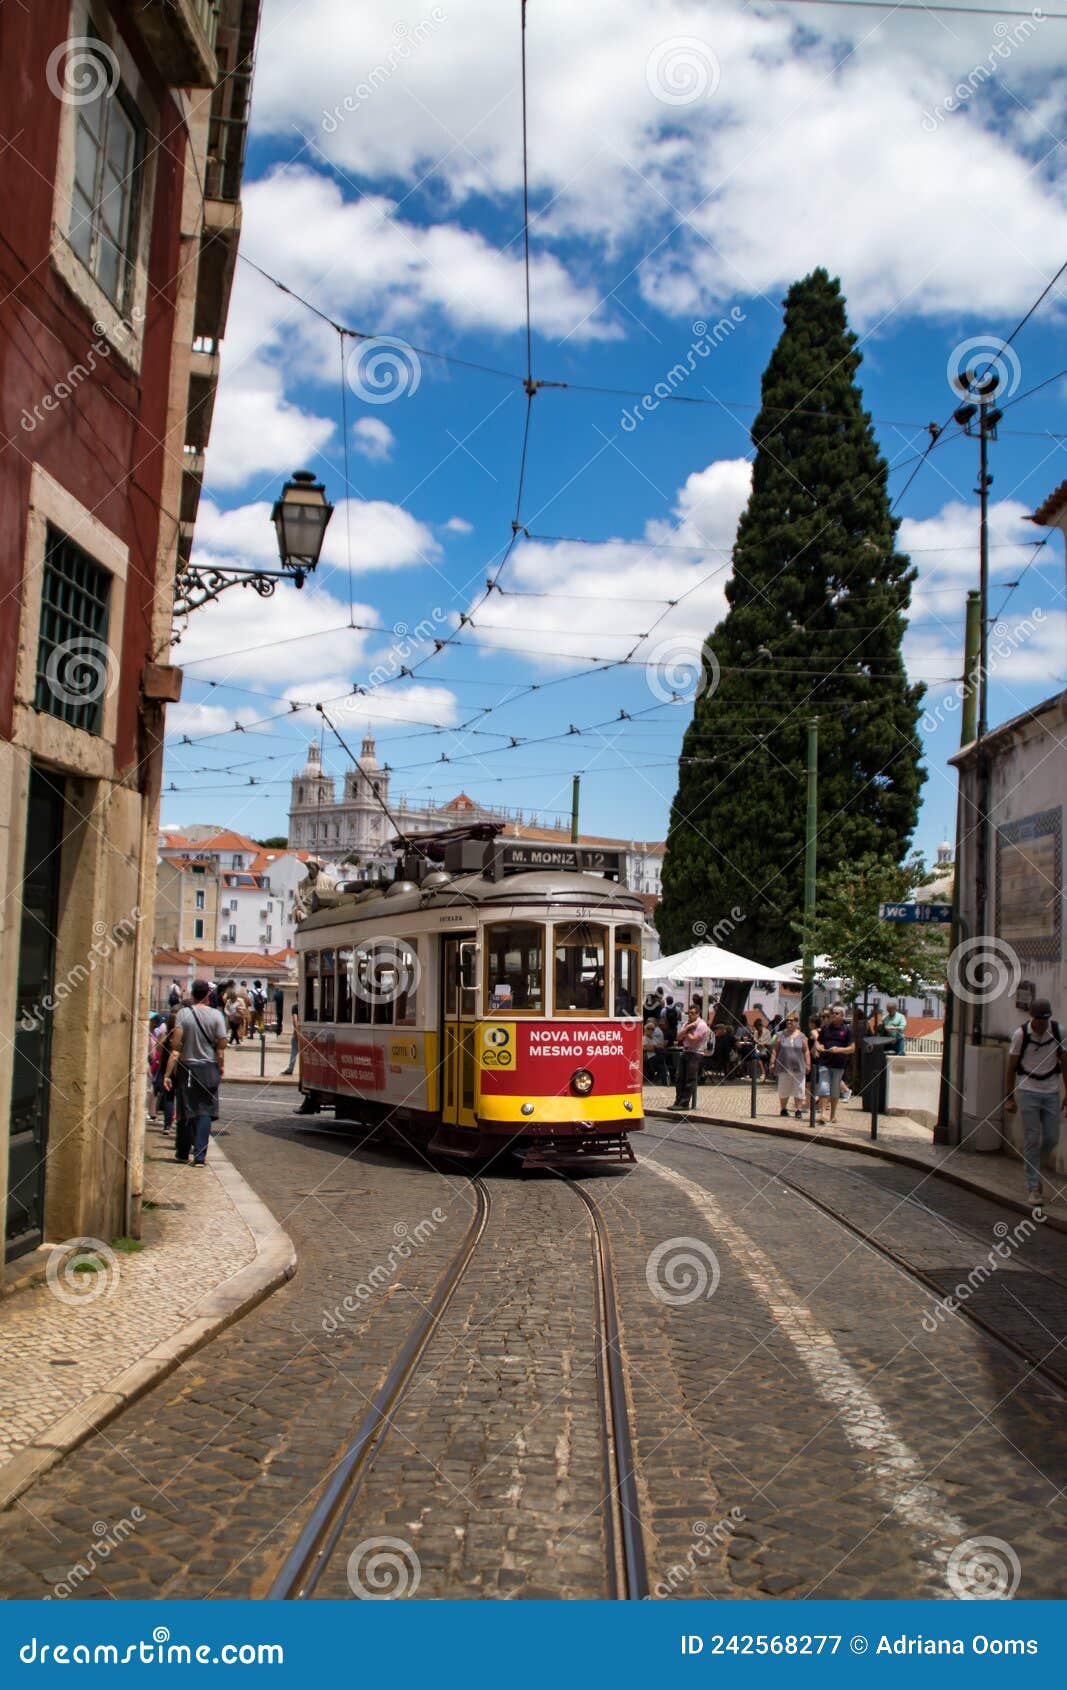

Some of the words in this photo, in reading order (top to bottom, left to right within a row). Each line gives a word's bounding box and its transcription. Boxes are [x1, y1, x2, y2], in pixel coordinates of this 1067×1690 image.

[512, 850, 527, 861] M.
[531, 851, 574, 865] MONIZ
[586, 854, 605, 868] 12
[886, 907, 907, 918] WC
[530, 1031, 569, 1041] NOVA
[573, 1030, 623, 1042] IMAGEM,
[529, 1045, 583, 1056] MESMO
[586, 1045, 624, 1056] SABOR
